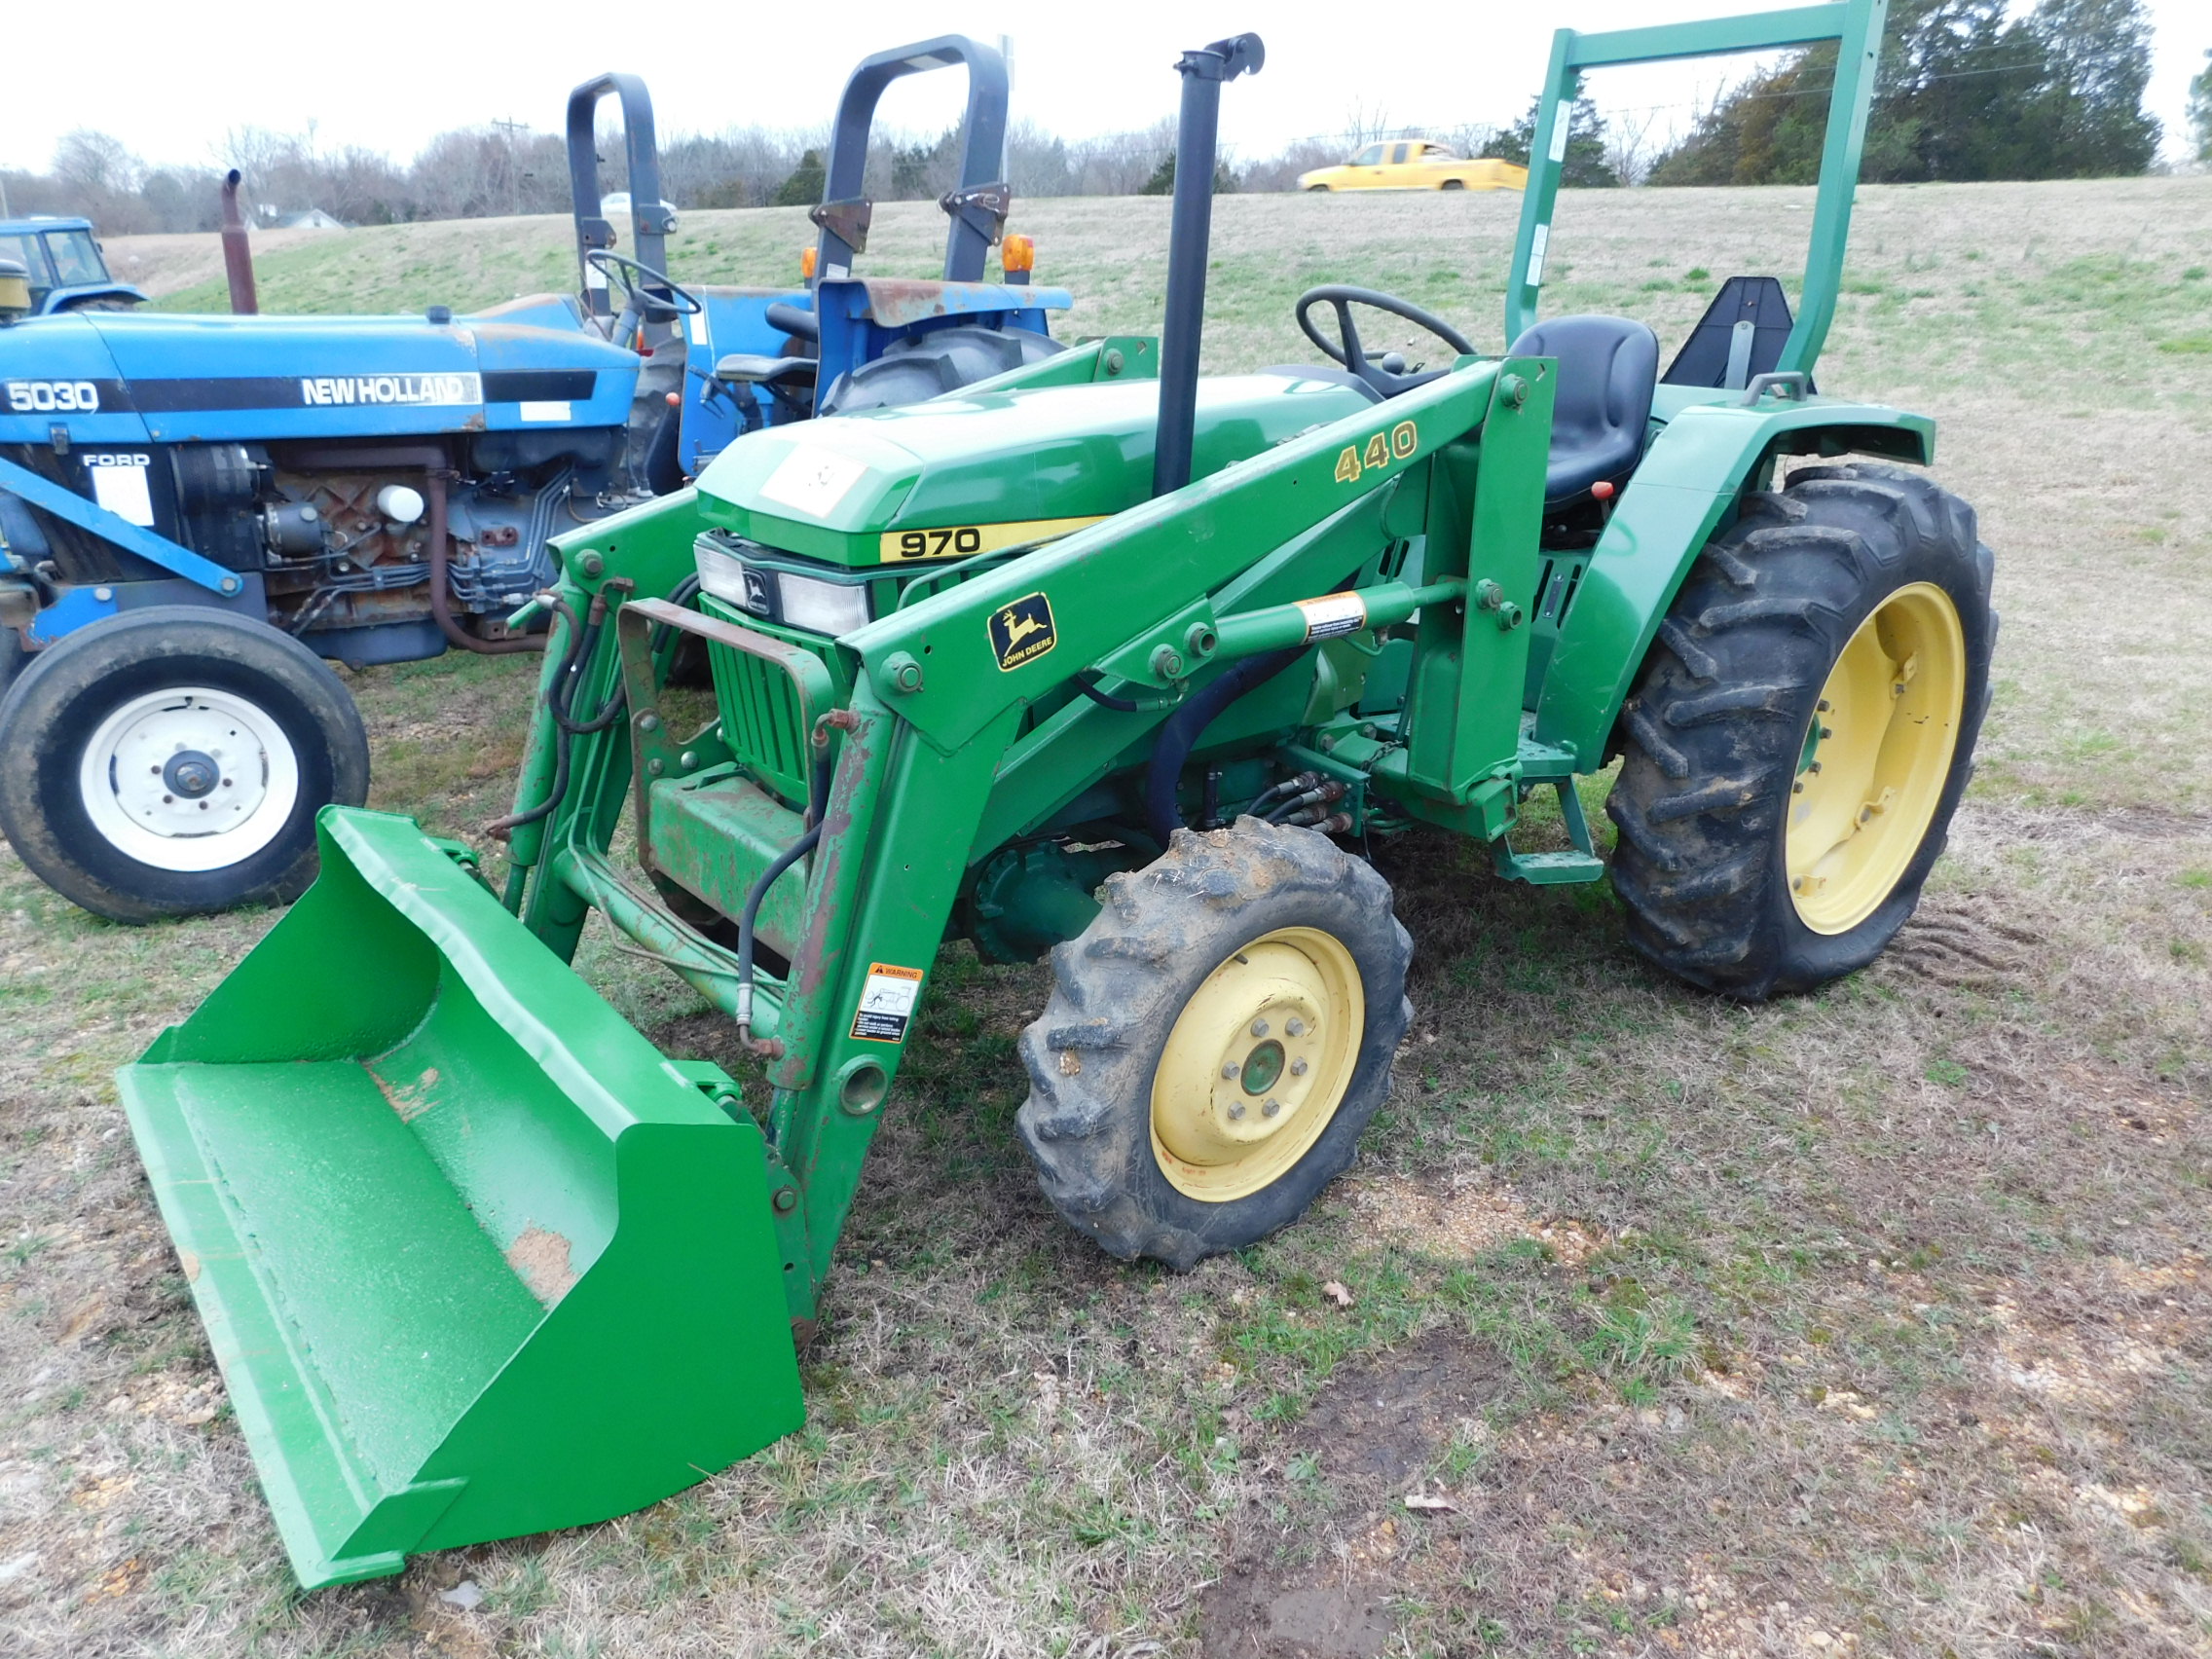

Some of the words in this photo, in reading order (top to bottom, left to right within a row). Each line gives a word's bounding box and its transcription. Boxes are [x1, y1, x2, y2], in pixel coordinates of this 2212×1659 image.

[8, 382, 99, 411] 5030
[302, 378, 354, 405] NEW
[356, 376, 464, 403] HOLLAND
[83, 454, 150, 466] FORD
[1335, 420, 1418, 483] 440
[901, 528, 980, 558] 970
[1003, 649, 1025, 667] JOHN
[1025, 636, 1052, 655] DEERE
[885, 968, 918, 979] WARNING
